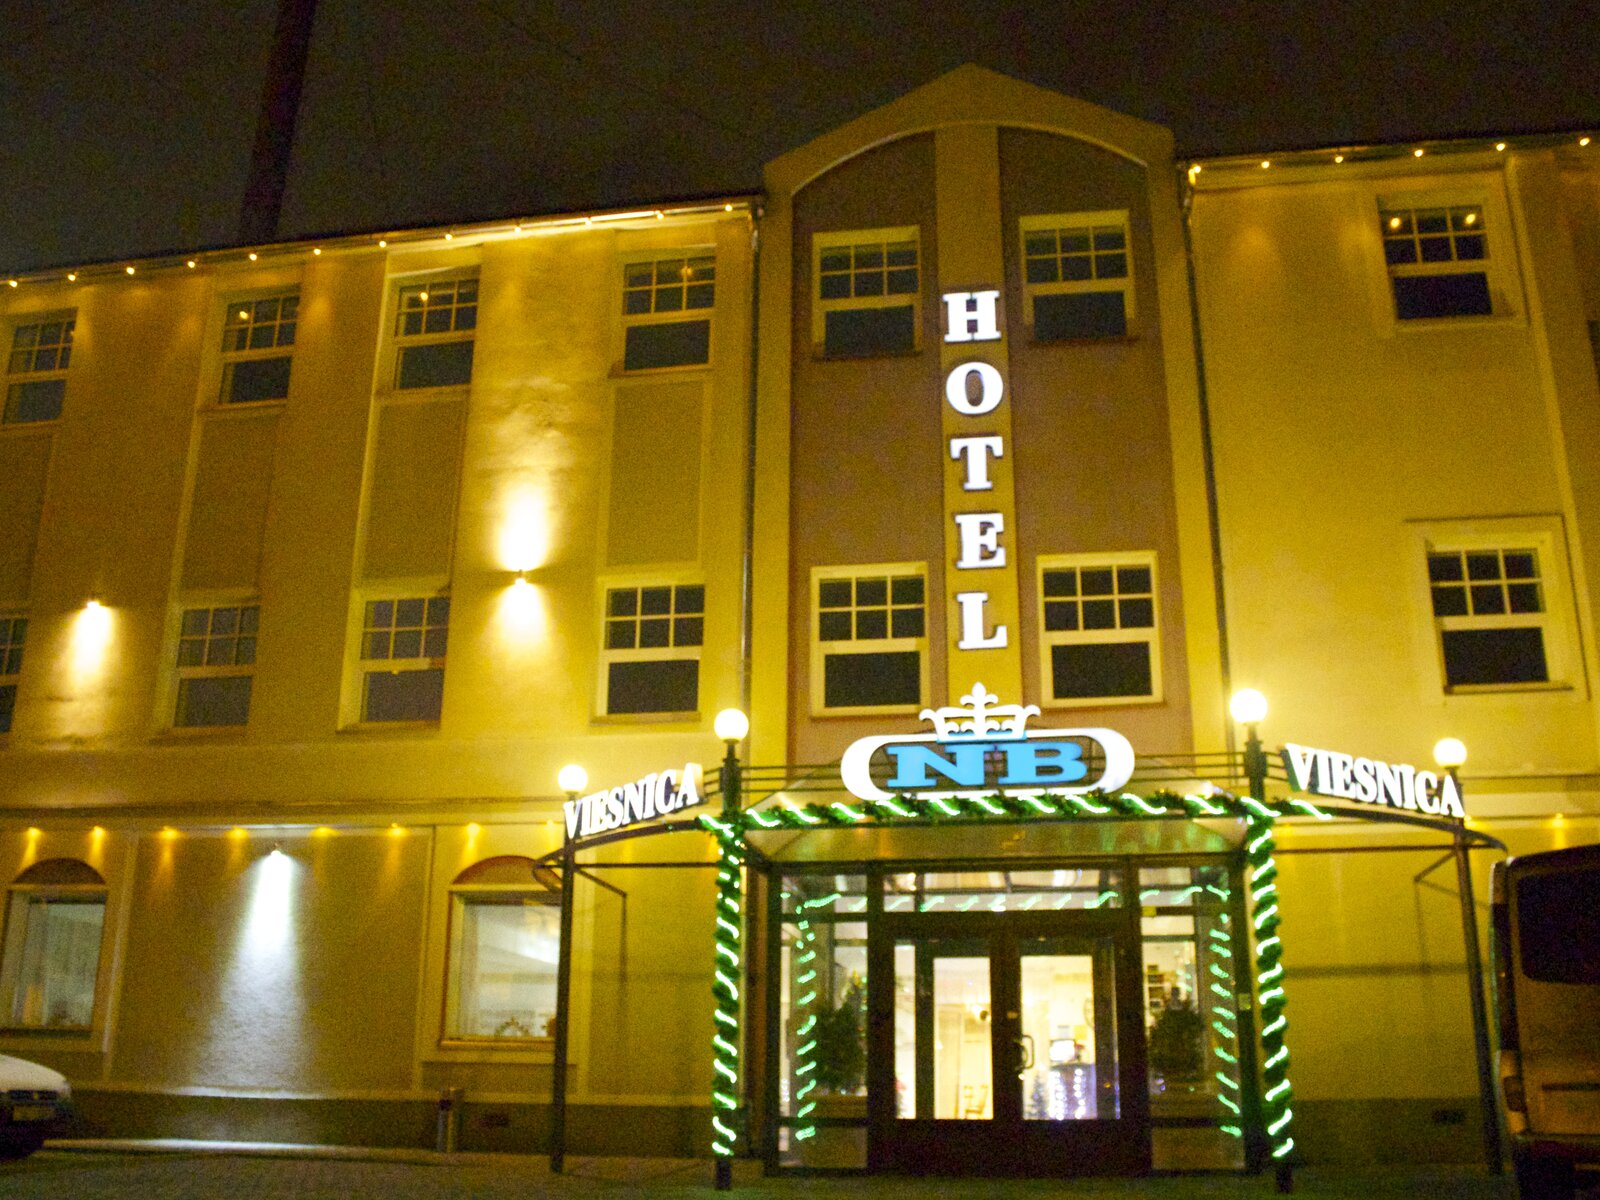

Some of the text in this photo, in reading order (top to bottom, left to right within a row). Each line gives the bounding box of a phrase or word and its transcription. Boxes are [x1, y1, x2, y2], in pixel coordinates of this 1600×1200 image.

[942, 290, 1008, 650] HOTEL
[563, 762, 702, 840] VIESNICA
[885, 741, 1088, 788] NB
[1284, 742, 1465, 818] VIESNICA
